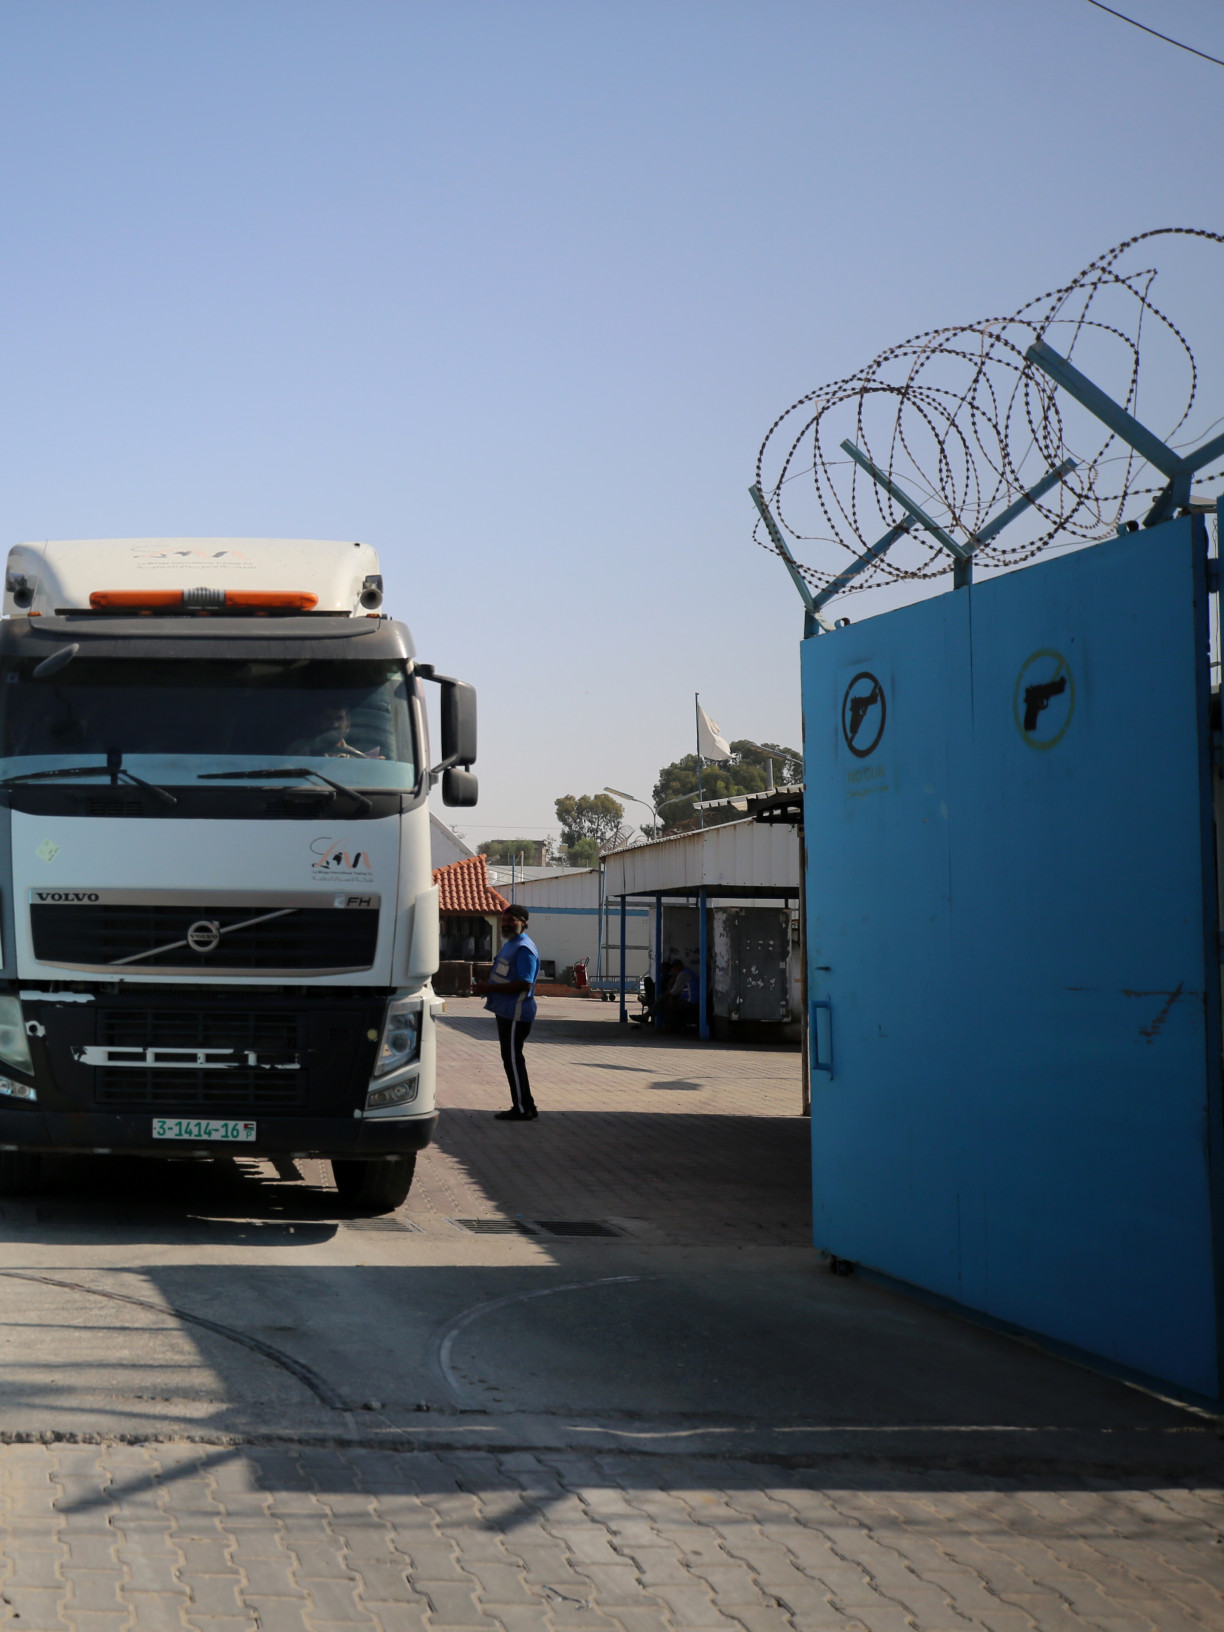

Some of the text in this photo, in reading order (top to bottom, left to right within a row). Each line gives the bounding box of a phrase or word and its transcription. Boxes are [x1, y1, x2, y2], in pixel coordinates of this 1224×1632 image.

[36, 892, 99, 902] VOLVO
[347, 896, 371, 907] FH
[157, 1120, 240, 1139] 3-1414-16
